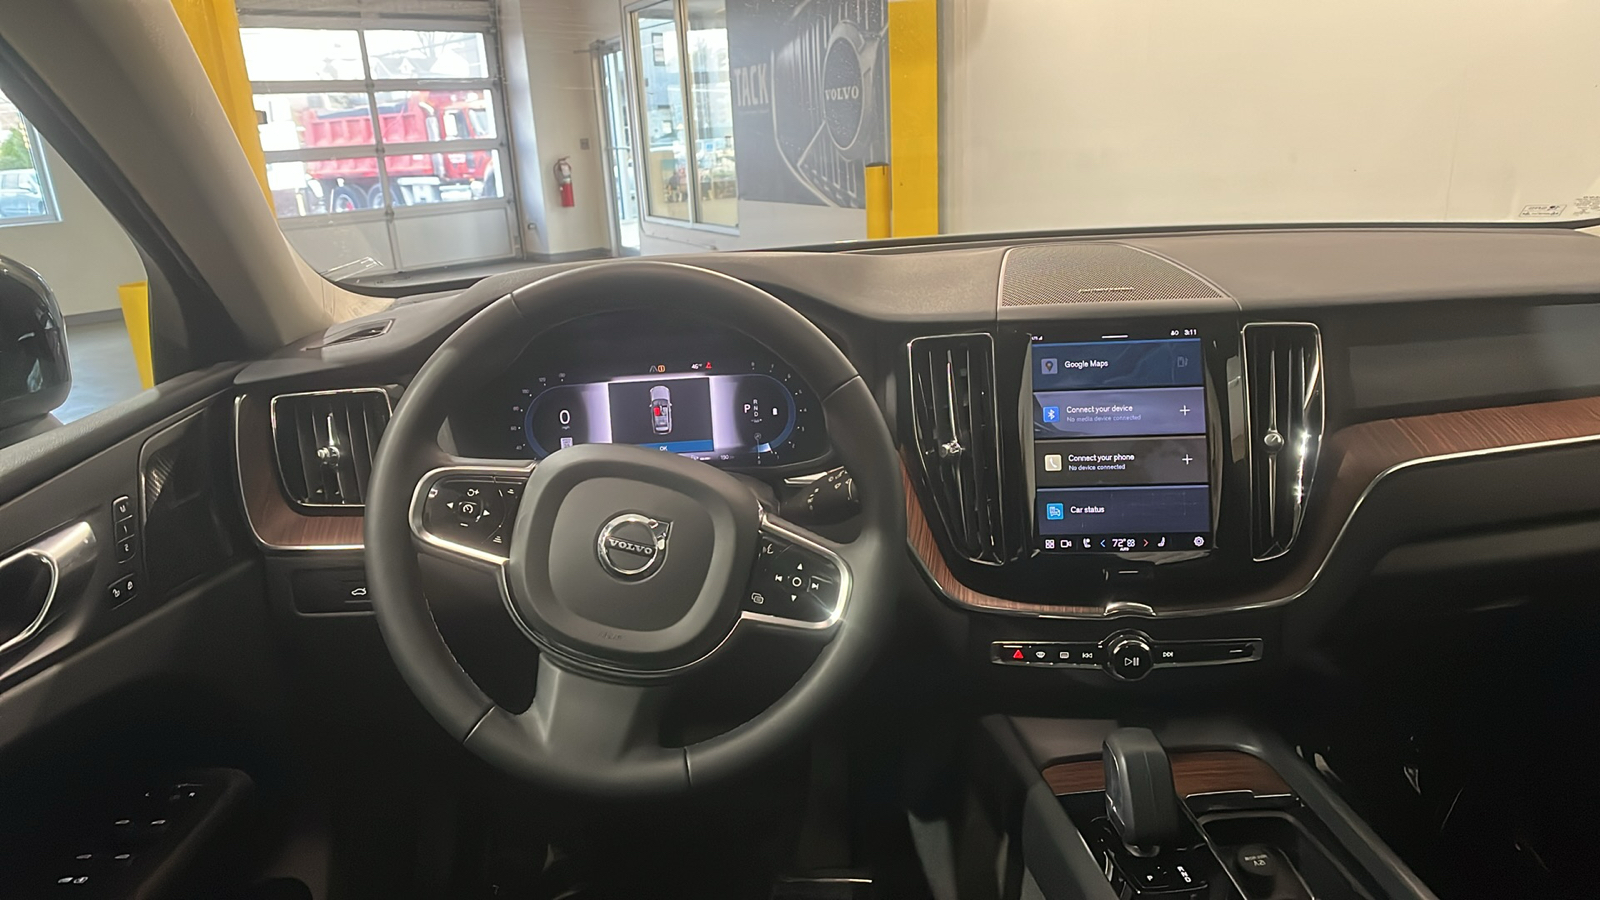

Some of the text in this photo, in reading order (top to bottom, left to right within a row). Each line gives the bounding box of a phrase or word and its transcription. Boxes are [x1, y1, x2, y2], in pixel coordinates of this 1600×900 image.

[733, 62, 769, 107] TACK
[824, 85, 860, 101] VOLVO
[1064, 360, 1109, 370] Google Maps
[743, 404, 751, 414] P
[1066, 405, 1096, 414] Connect
[1096, 406, 1110, 414] your
[559, 409, 571, 425] 0
[1068, 453, 1135, 463] Connect your phone
[1097, 463, 1126, 471] connected
[1070, 505, 1105, 514] Car status
[608, 538, 653, 555] VOLVO
